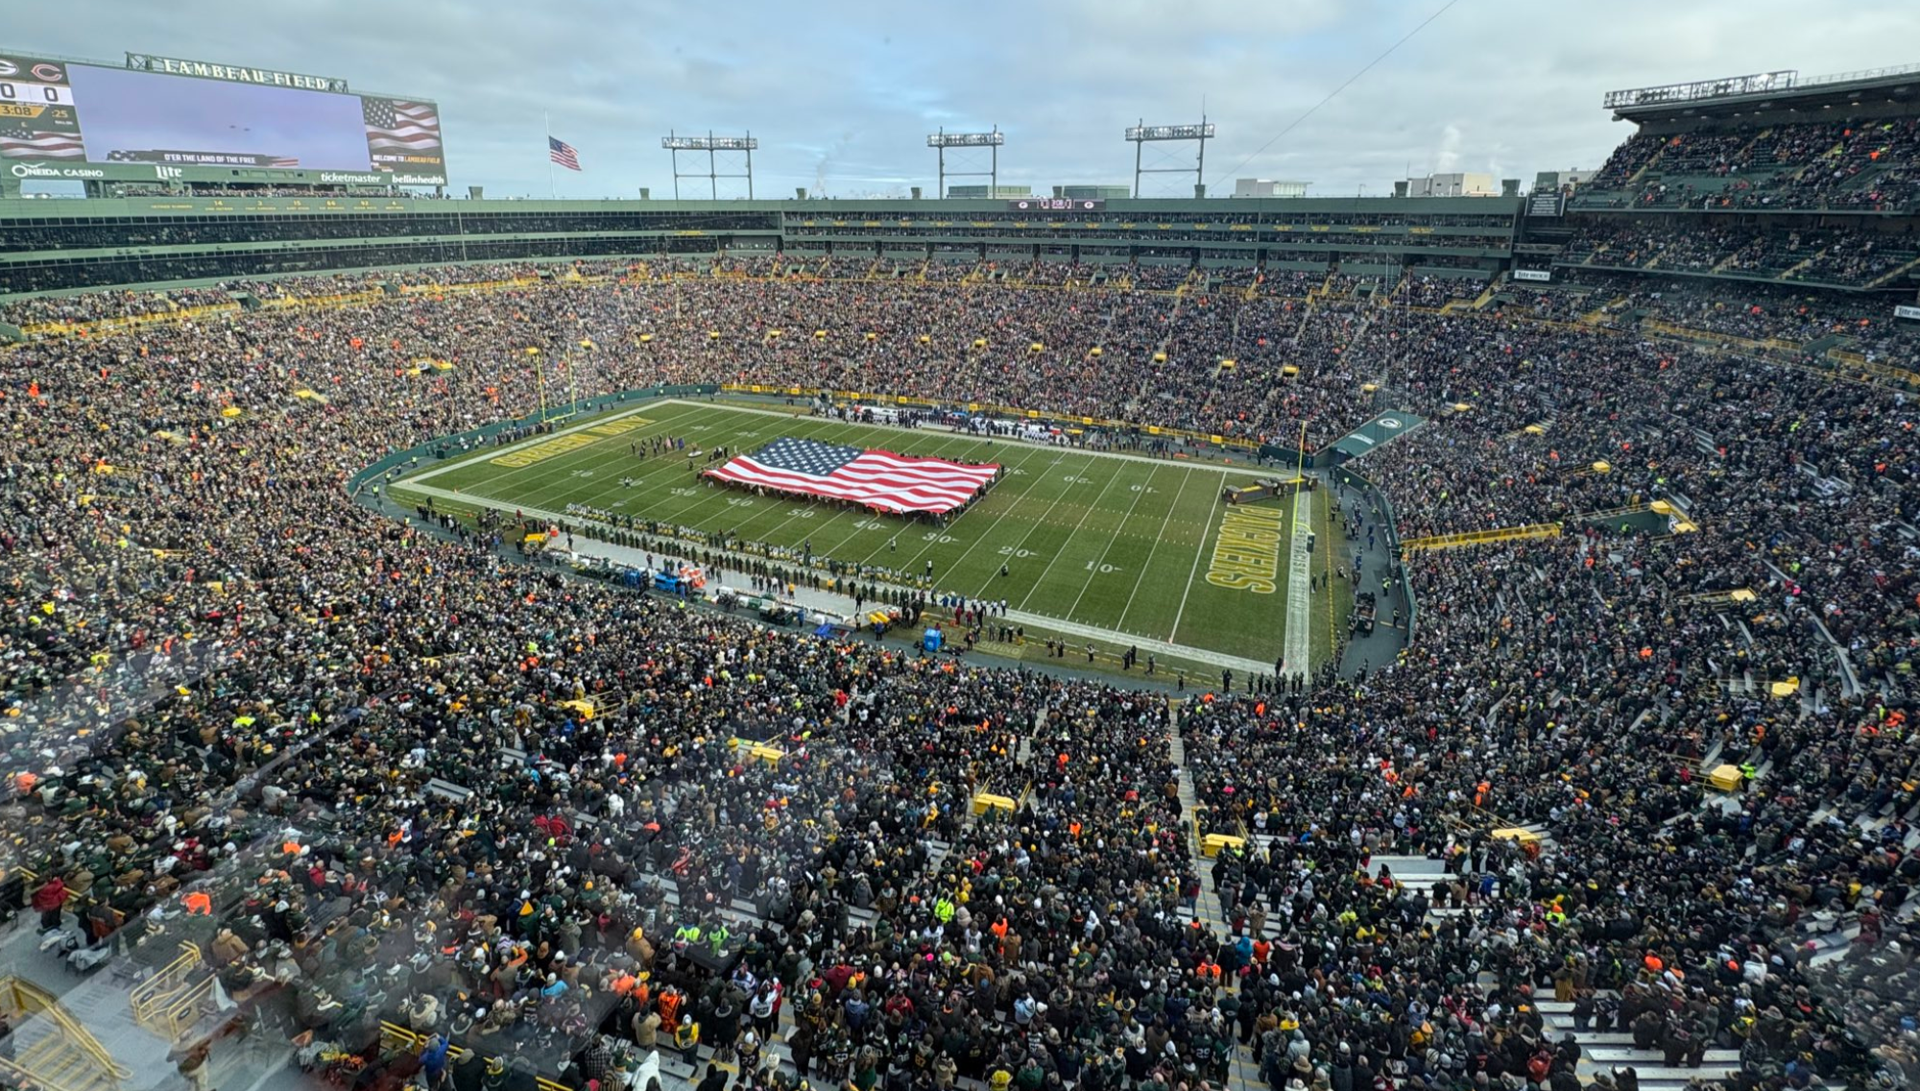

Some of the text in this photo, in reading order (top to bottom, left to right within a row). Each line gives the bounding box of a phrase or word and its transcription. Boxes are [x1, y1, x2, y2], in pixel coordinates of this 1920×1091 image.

[163, 59, 326, 90] LAMBEAU FIELD
[0, 83, 59, 102] 0 0
[164, 153, 256, 164] O'ER THE LAND OF THE FREE
[372, 154, 397, 162] WELCOME
[11, 163, 104, 178] ONEIDA CASINO
[155, 166, 183, 179] Lite
[320, 172, 381, 184] ticketmaster
[588, 415, 656, 435] BAY
[489, 433, 603, 468] GREEN
[786, 508, 815, 519] 50
[853, 520, 881, 531] 40
[922, 532, 952, 544] 30
[998, 546, 1031, 558] 20
[1205, 502, 1284, 594] PACKERS
[1084, 560, 1115, 574] 10
[711, 867, 721, 878] 21
[741, 1055, 756, 1067] 22
